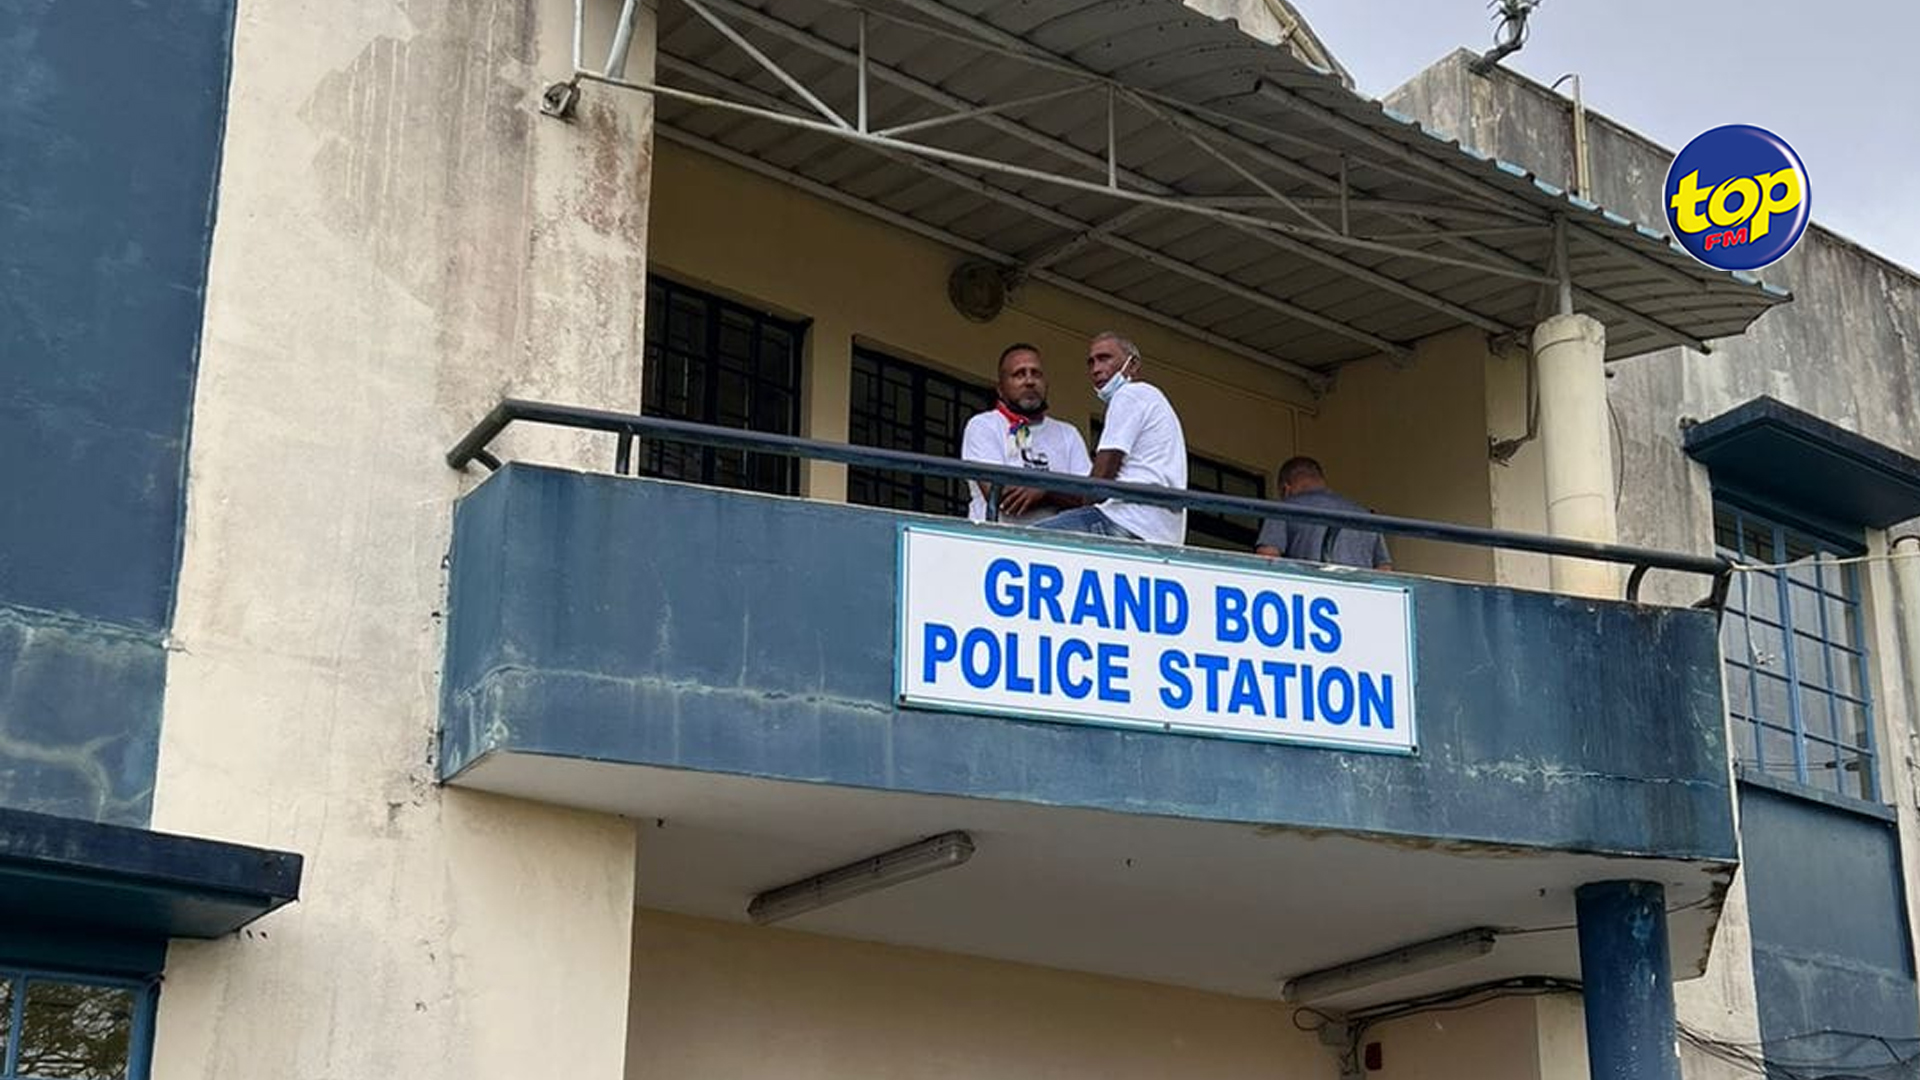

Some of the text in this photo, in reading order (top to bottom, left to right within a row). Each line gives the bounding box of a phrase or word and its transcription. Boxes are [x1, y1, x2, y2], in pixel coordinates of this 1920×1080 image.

[983, 557, 1343, 654] GRAND BOIS
[922, 622, 1395, 730] POLICE STATION
